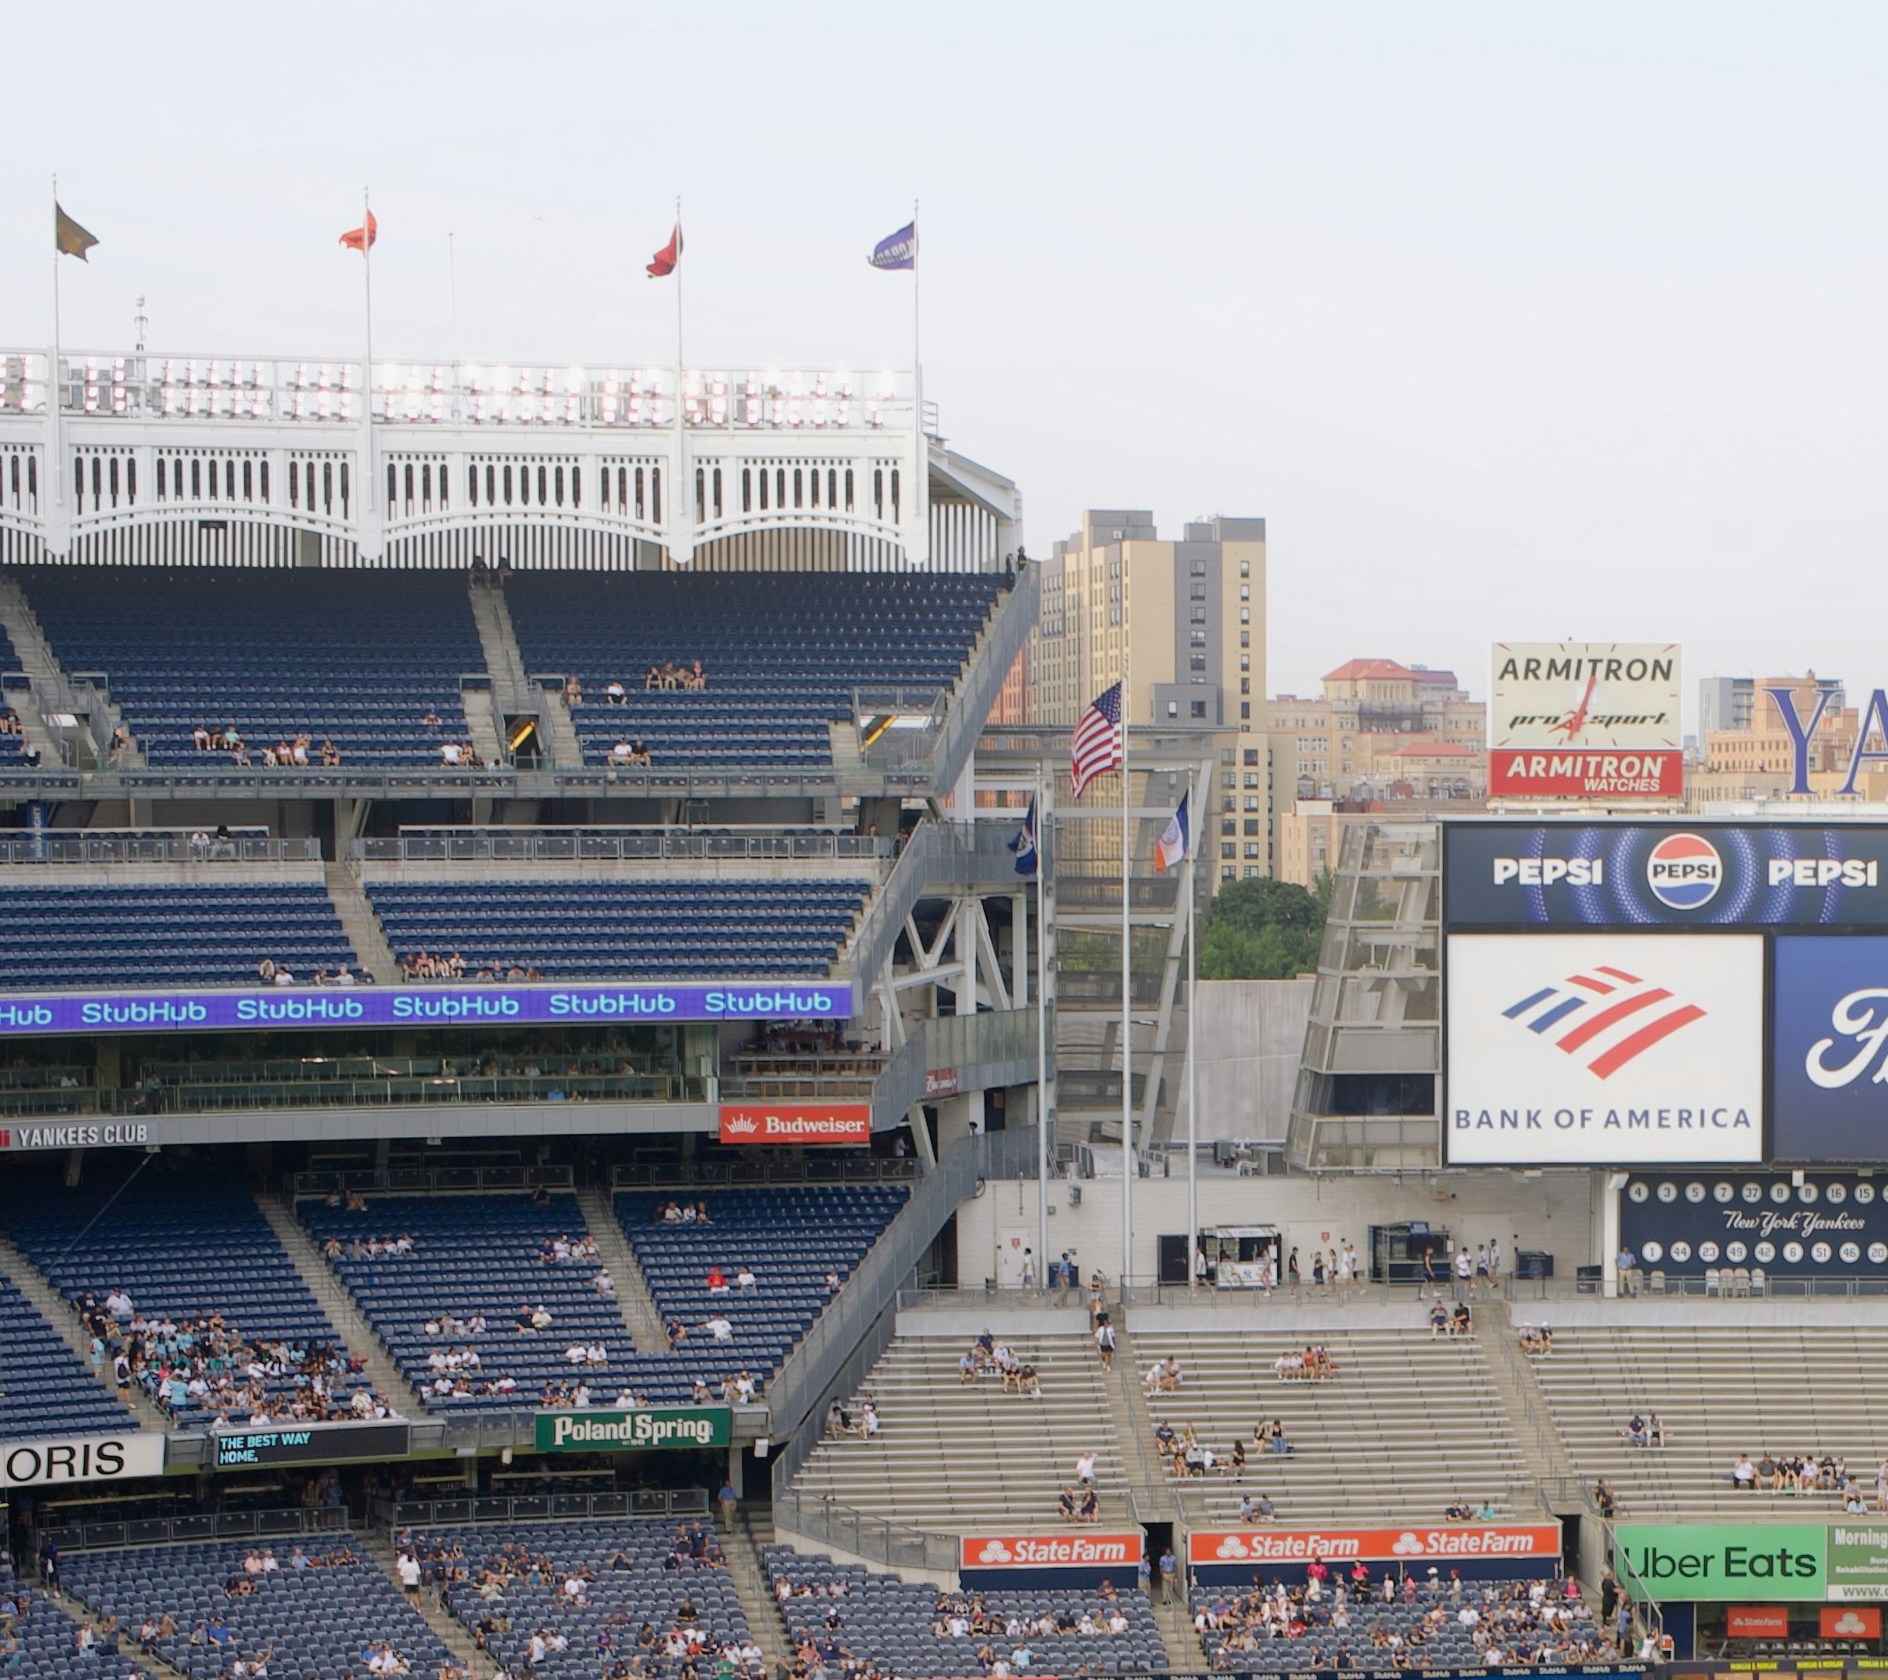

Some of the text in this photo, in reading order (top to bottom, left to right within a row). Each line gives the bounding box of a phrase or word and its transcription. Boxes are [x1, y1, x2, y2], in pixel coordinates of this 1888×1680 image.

[1499, 658, 1673, 681] ARMITRON
[1508, 758, 1662, 778] ARMITRON
[1583, 778, 1660, 791] WATCHES
[1494, 858, 1602, 886] PEPSI
[1652, 862, 1718, 880] PEPSI
[1769, 859, 1877, 887] PEPSI
[82, 1001, 206, 1023] StubHub
[237, 999, 362, 1020] StubHub
[392, 995, 520, 1018] StubHub
[549, 994, 675, 1014] StubHub
[705, 992, 832, 1012] StubHub
[765, 1117, 864, 1135] Budweiser
[1456, 1108, 1750, 1129] BANK OF AMERICA
[19, 1125, 147, 1146] YANKEES CLUB
[1722, 1211, 1864, 1237] New York Yankees
[554, 1414, 710, 1445] Poland Spring
[220, 1432, 310, 1450] THE BEST WAY
[7, 1442, 124, 1482] ORIS
[1625, 1547, 1817, 1578] Uber Eats
